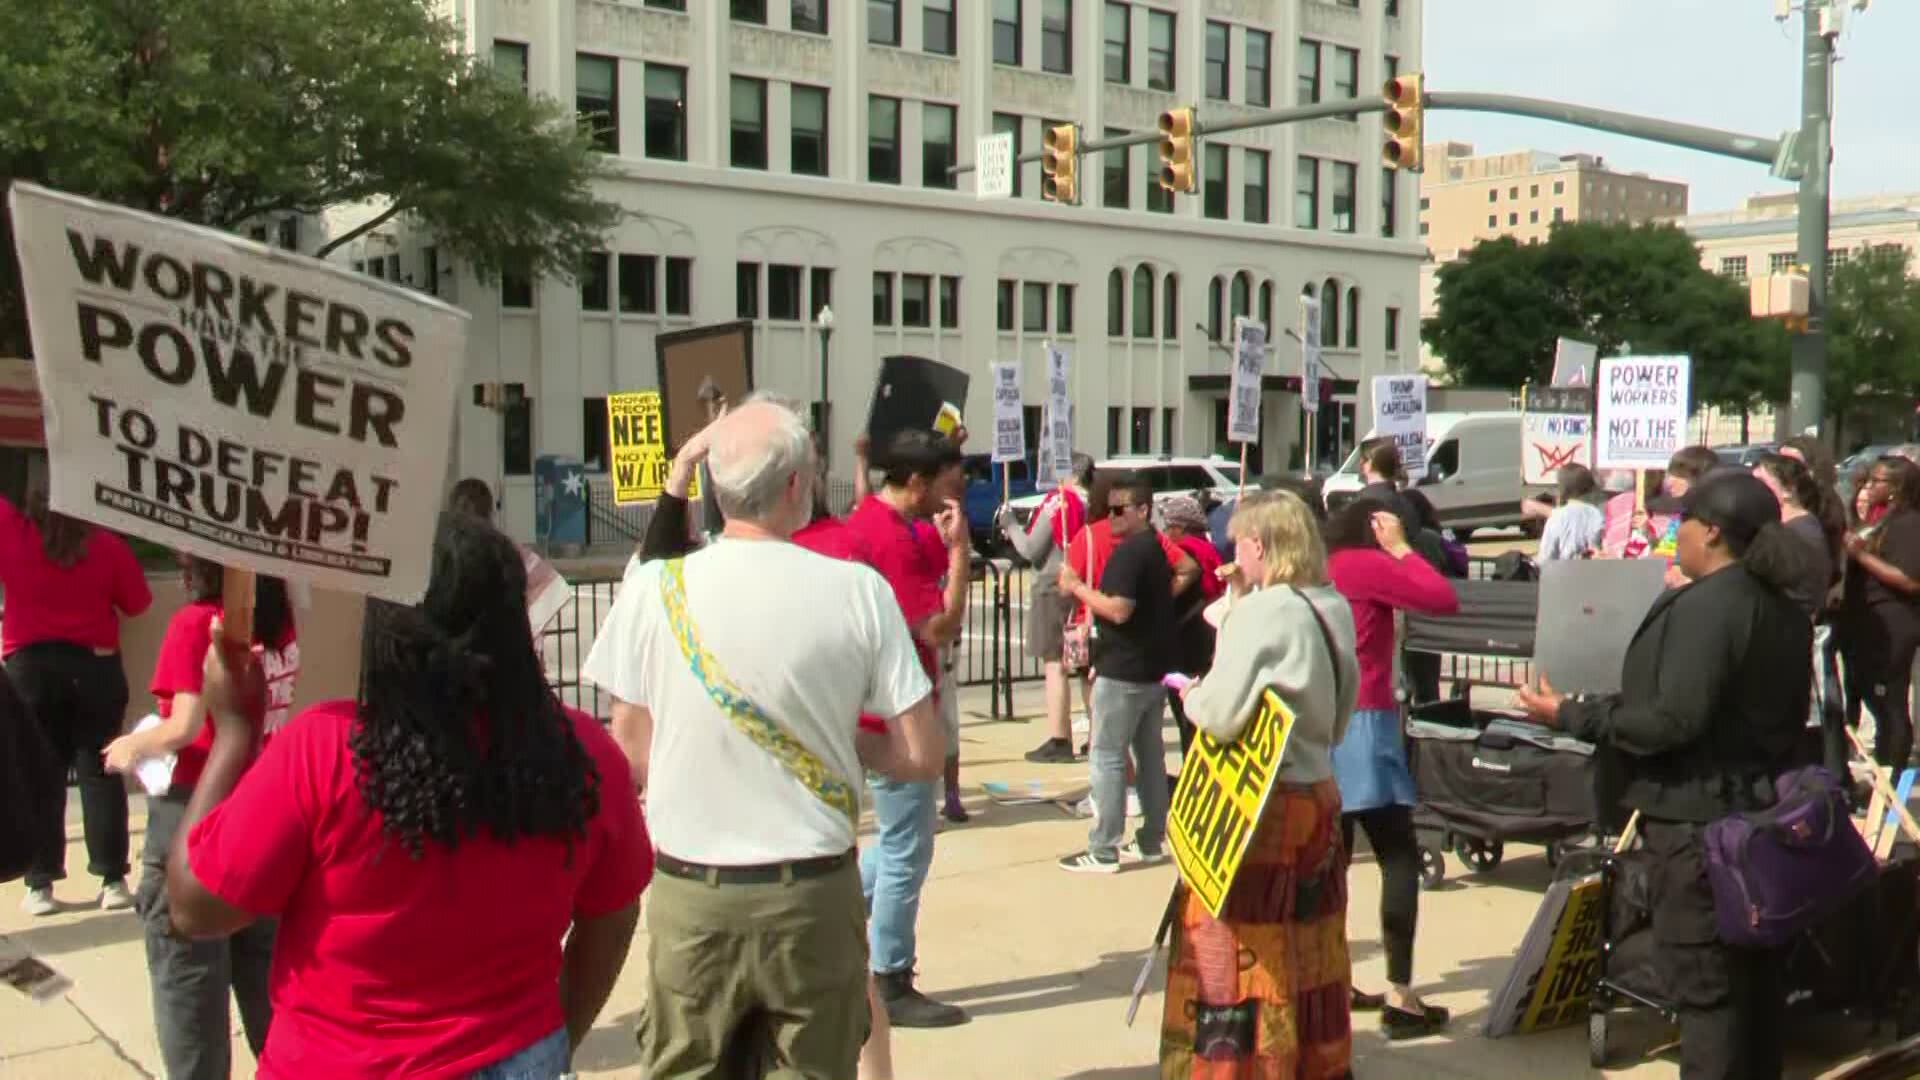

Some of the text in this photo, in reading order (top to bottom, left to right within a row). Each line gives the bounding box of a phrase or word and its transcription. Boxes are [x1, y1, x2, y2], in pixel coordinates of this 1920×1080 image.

[66, 228, 414, 368] WORKERS
[77, 302, 406, 449] POWER
[1610, 365, 1678, 386] POWER
[611, 404, 662, 414] PEOP
[1610, 389, 1678, 405] WORKERS
[612, 415, 661, 446] NEE
[1609, 419, 1676, 439] NOT THE
[89, 395, 399, 514] TO DEFEAT
[615, 453, 648, 462] NOT
[617, 463, 644, 487] W/
[116, 444, 371, 553] TRUMP!
[1173, 747, 1250, 884] IRAN!
